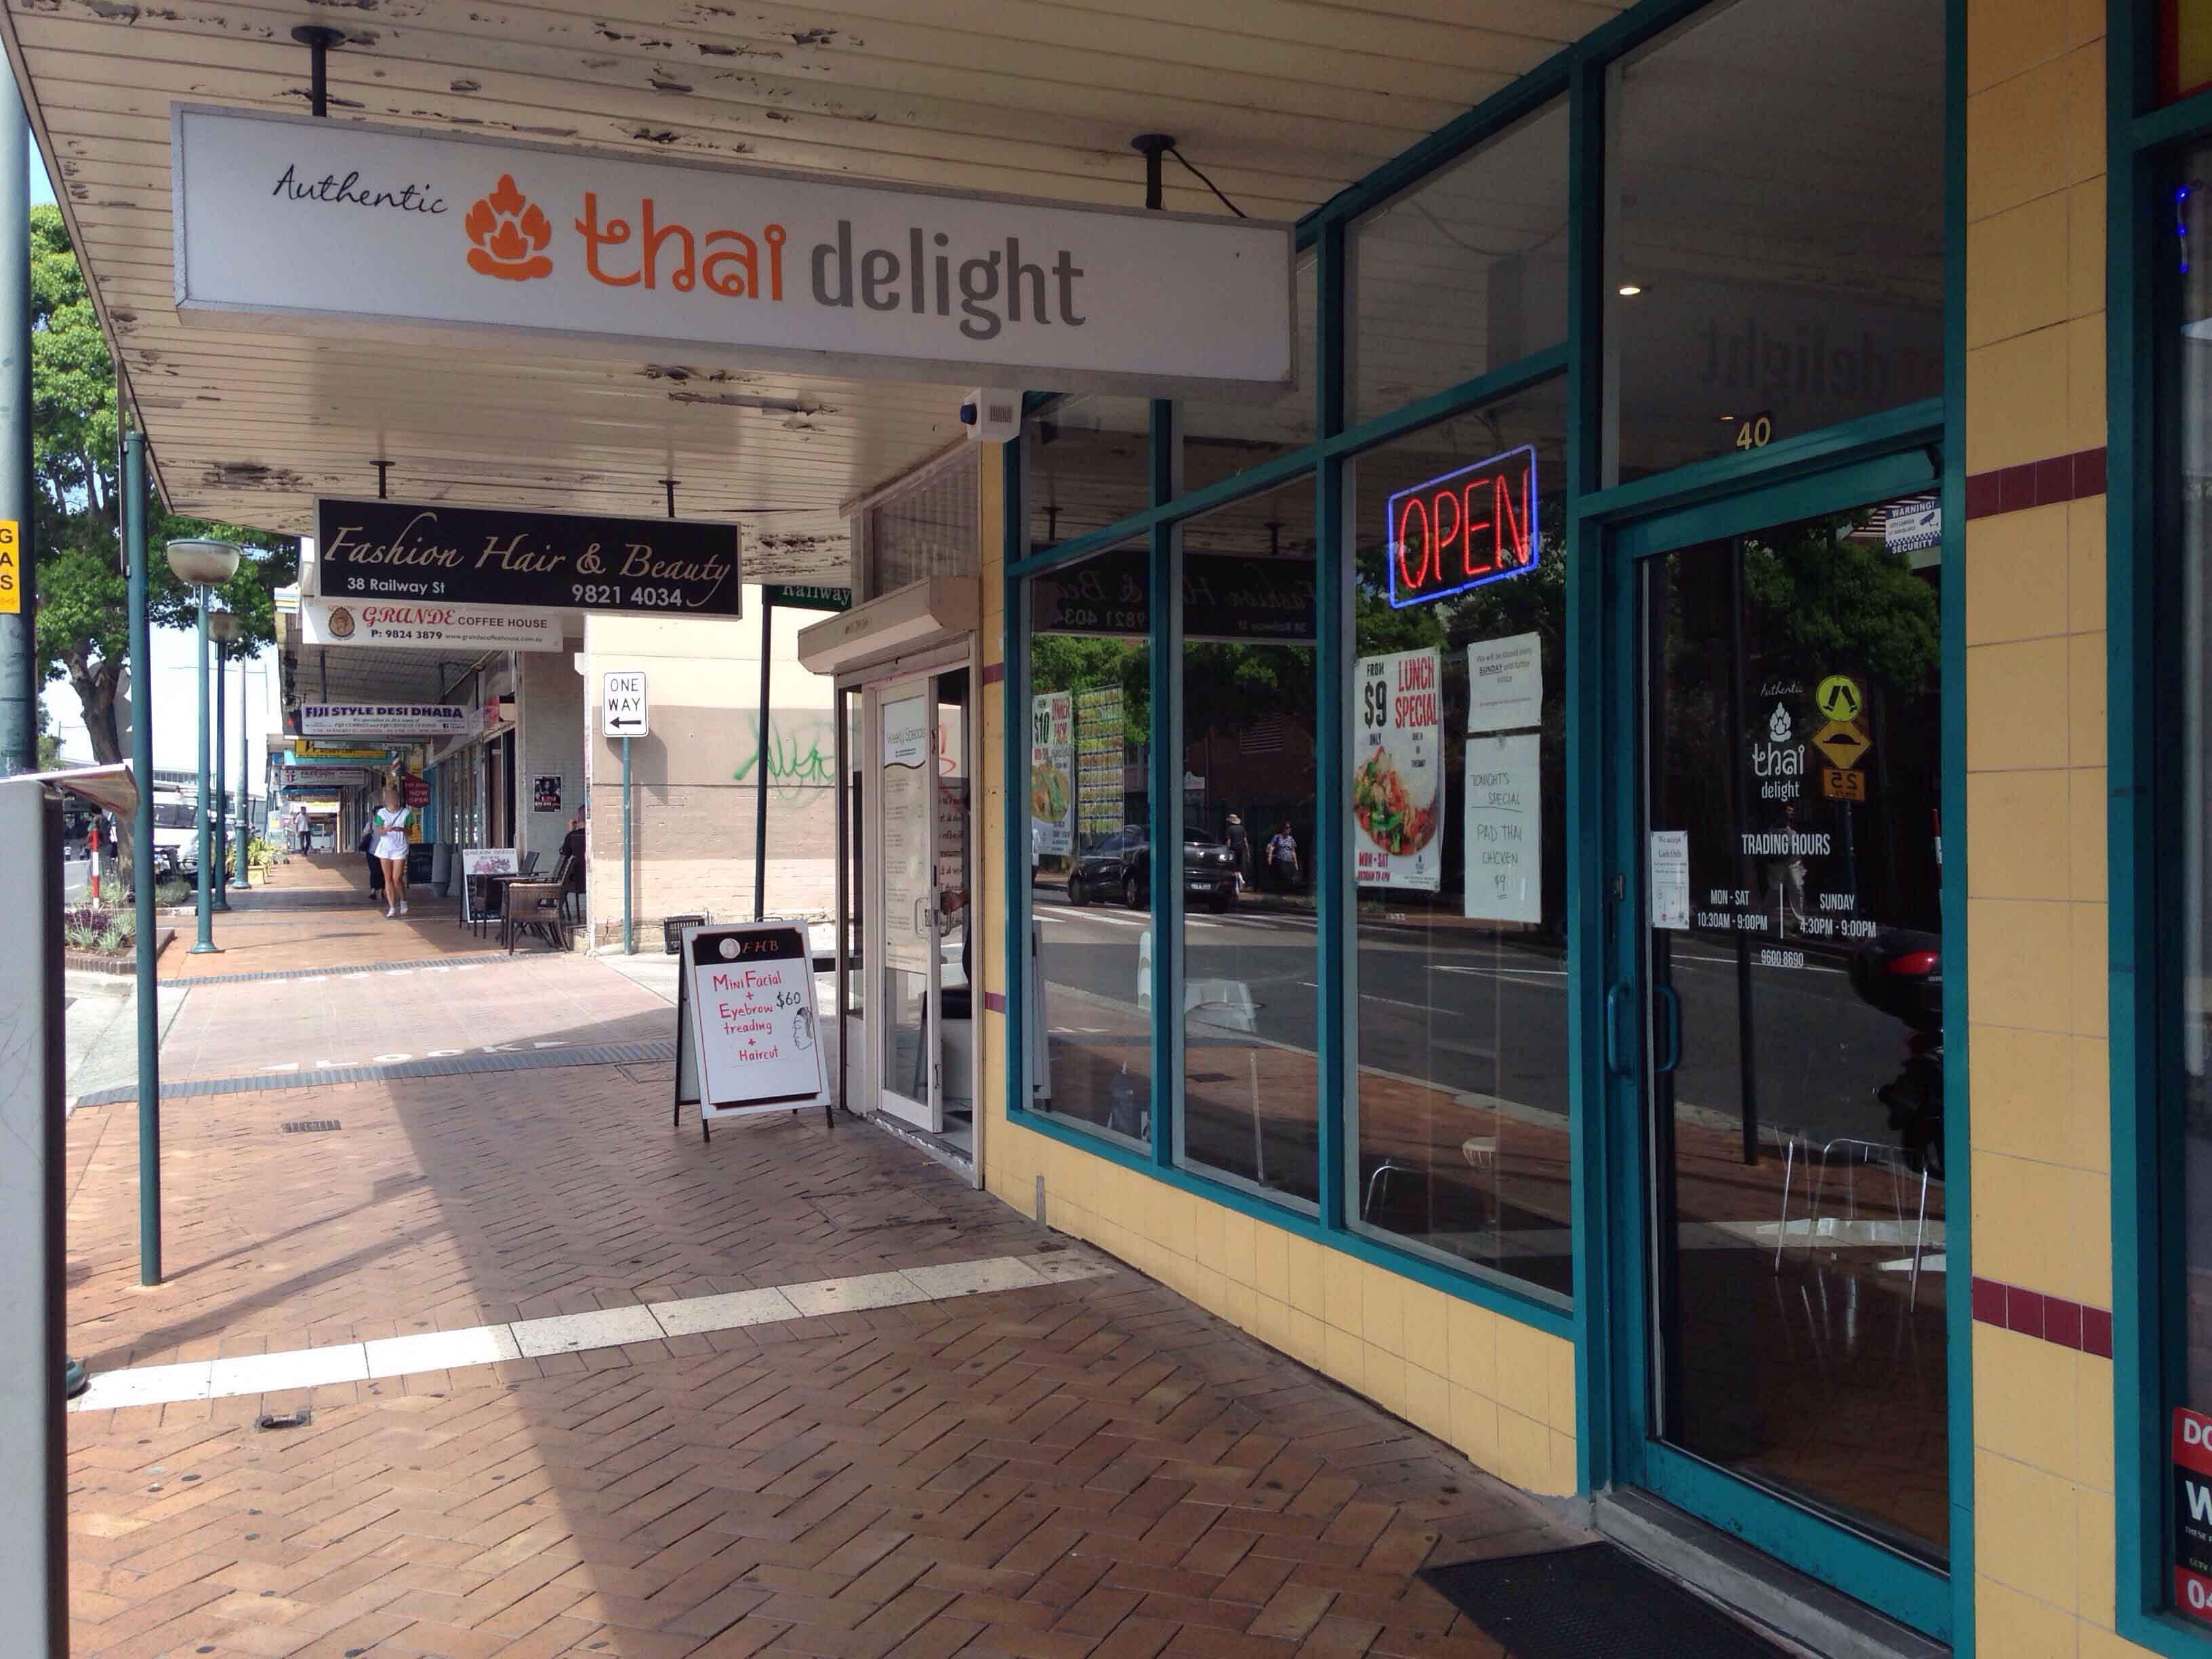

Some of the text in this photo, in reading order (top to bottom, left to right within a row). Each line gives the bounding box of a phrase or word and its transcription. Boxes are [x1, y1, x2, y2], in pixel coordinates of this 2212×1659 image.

[272, 163, 449, 214] Authentic
[575, 192, 1086, 340] thai delight
[1736, 416, 1771, 451] 40
[1891, 500, 1935, 518] WARNING!
[1398, 466, 1530, 589] OPEN
[1891, 539, 1933, 554] SECURITY
[0, 529, 14, 590] GAS
[324, 512, 731, 607] Fashion Hair & Beauty
[347, 577, 445, 595] 38 Railway St
[571, 584, 682, 606] 9821 4034
[362, 606, 548, 629] GRANDE COFFEE HOUSE
[371, 630, 383, 639] P:
[385, 630, 413, 639] 9824
[416, 630, 443, 640] 3879
[1366, 655, 1435, 693] FROM LUNCH
[1479, 662, 1502, 676] SUNDAY
[610, 678, 639, 693] ONE
[305, 706, 464, 718] FIJI STYLE DESI DHABA
[607, 697, 640, 712] WAY
[1364, 680, 1438, 730] $9 SPECIAL
[1034, 711, 1050, 744] $10
[1752, 741, 1805, 777] thai
[1487, 792, 1521, 806] SPECIAL
[1761, 779, 1801, 802] delight
[1476, 823, 1523, 843] PAD THAI
[1741, 832, 1831, 856] TRADING HOURS
[1481, 851, 1519, 865] CHICKEN
[1710, 888, 1729, 906] MON
[1734, 889, 1750, 907] SAT
[1819, 893, 1856, 912] SUNDAY
[1697, 912, 1731, 929] 10:30AM
[1736, 912, 1767, 931] 9:00PM
[1799, 918, 1834, 937] 4:30PM
[1841, 918, 1877, 939] 9:00PM
[1761, 949, 1804, 968] 9600 8690
[744, 970, 781, 988] Facial
[776, 991, 801, 1009] $60
[719, 1002, 774, 1021] Eyebrow
[738, 1045, 779, 1061] Haircut
